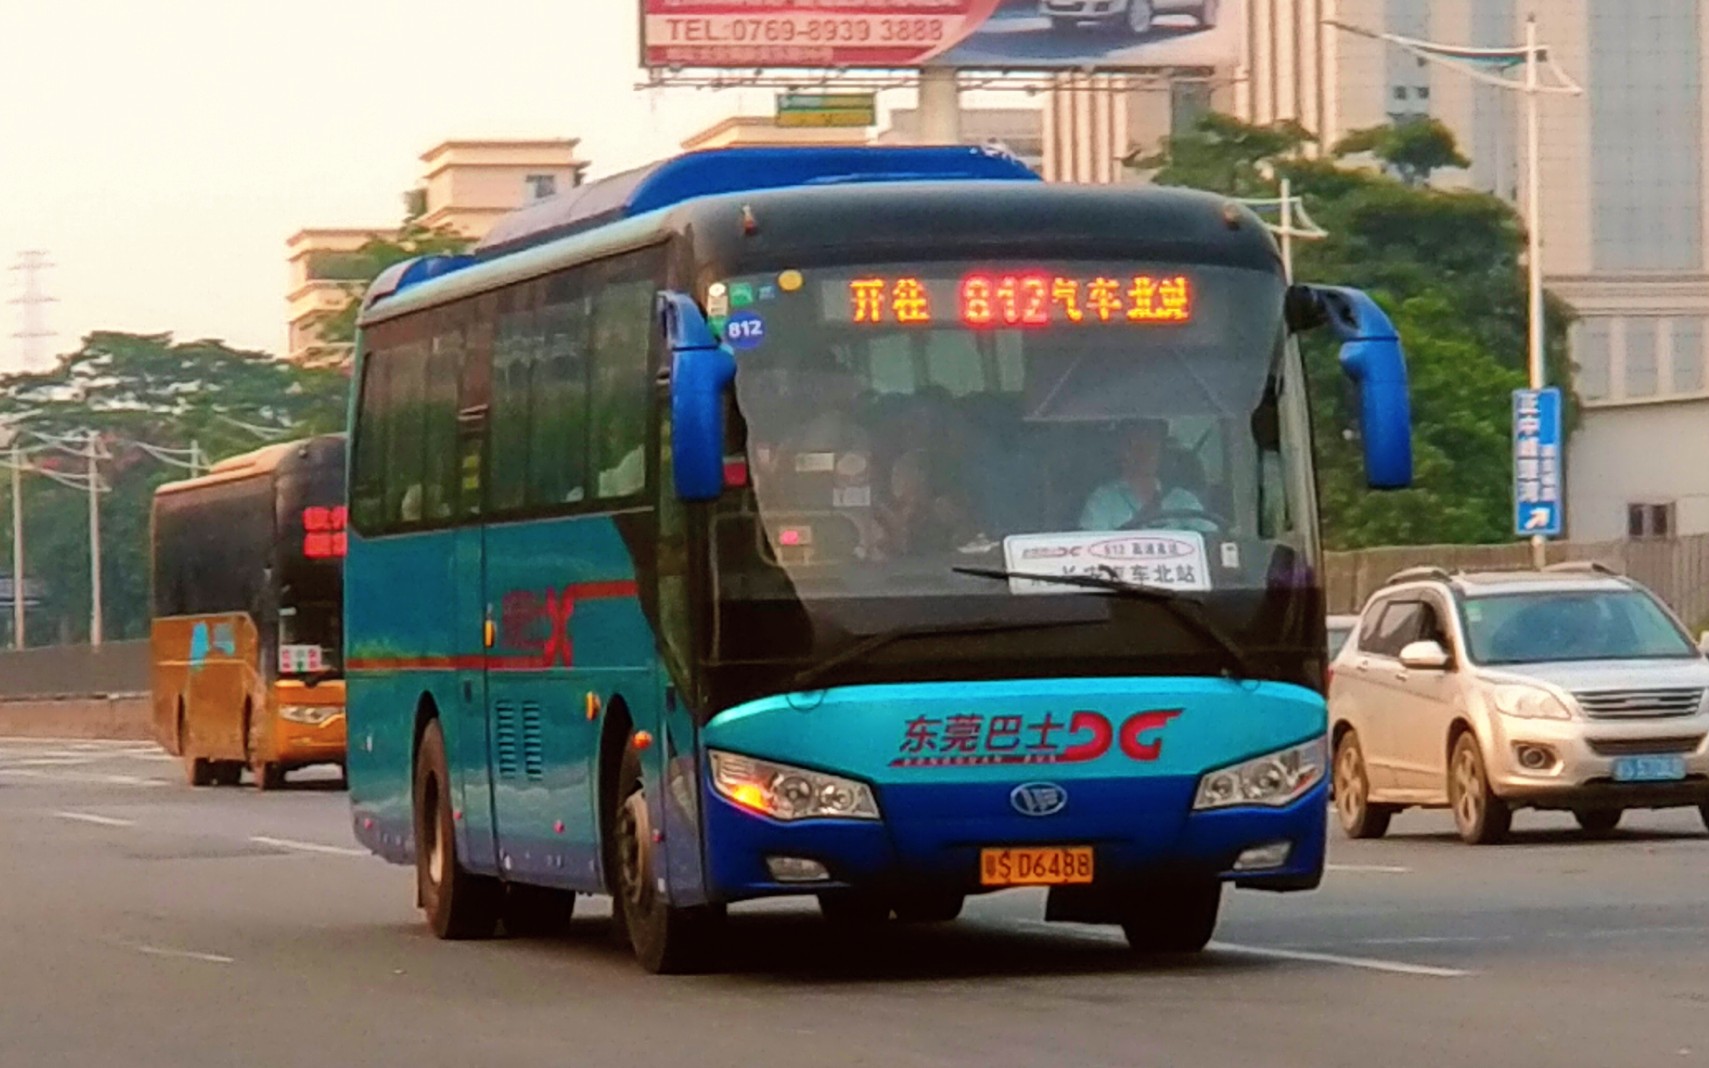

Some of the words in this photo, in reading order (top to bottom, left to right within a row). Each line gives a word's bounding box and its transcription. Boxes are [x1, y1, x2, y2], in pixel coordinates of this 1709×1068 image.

[881, 19, 943, 41] 3888
[728, 319, 763, 338] 812
[899, 711, 1063, 753] 东莞巴士
